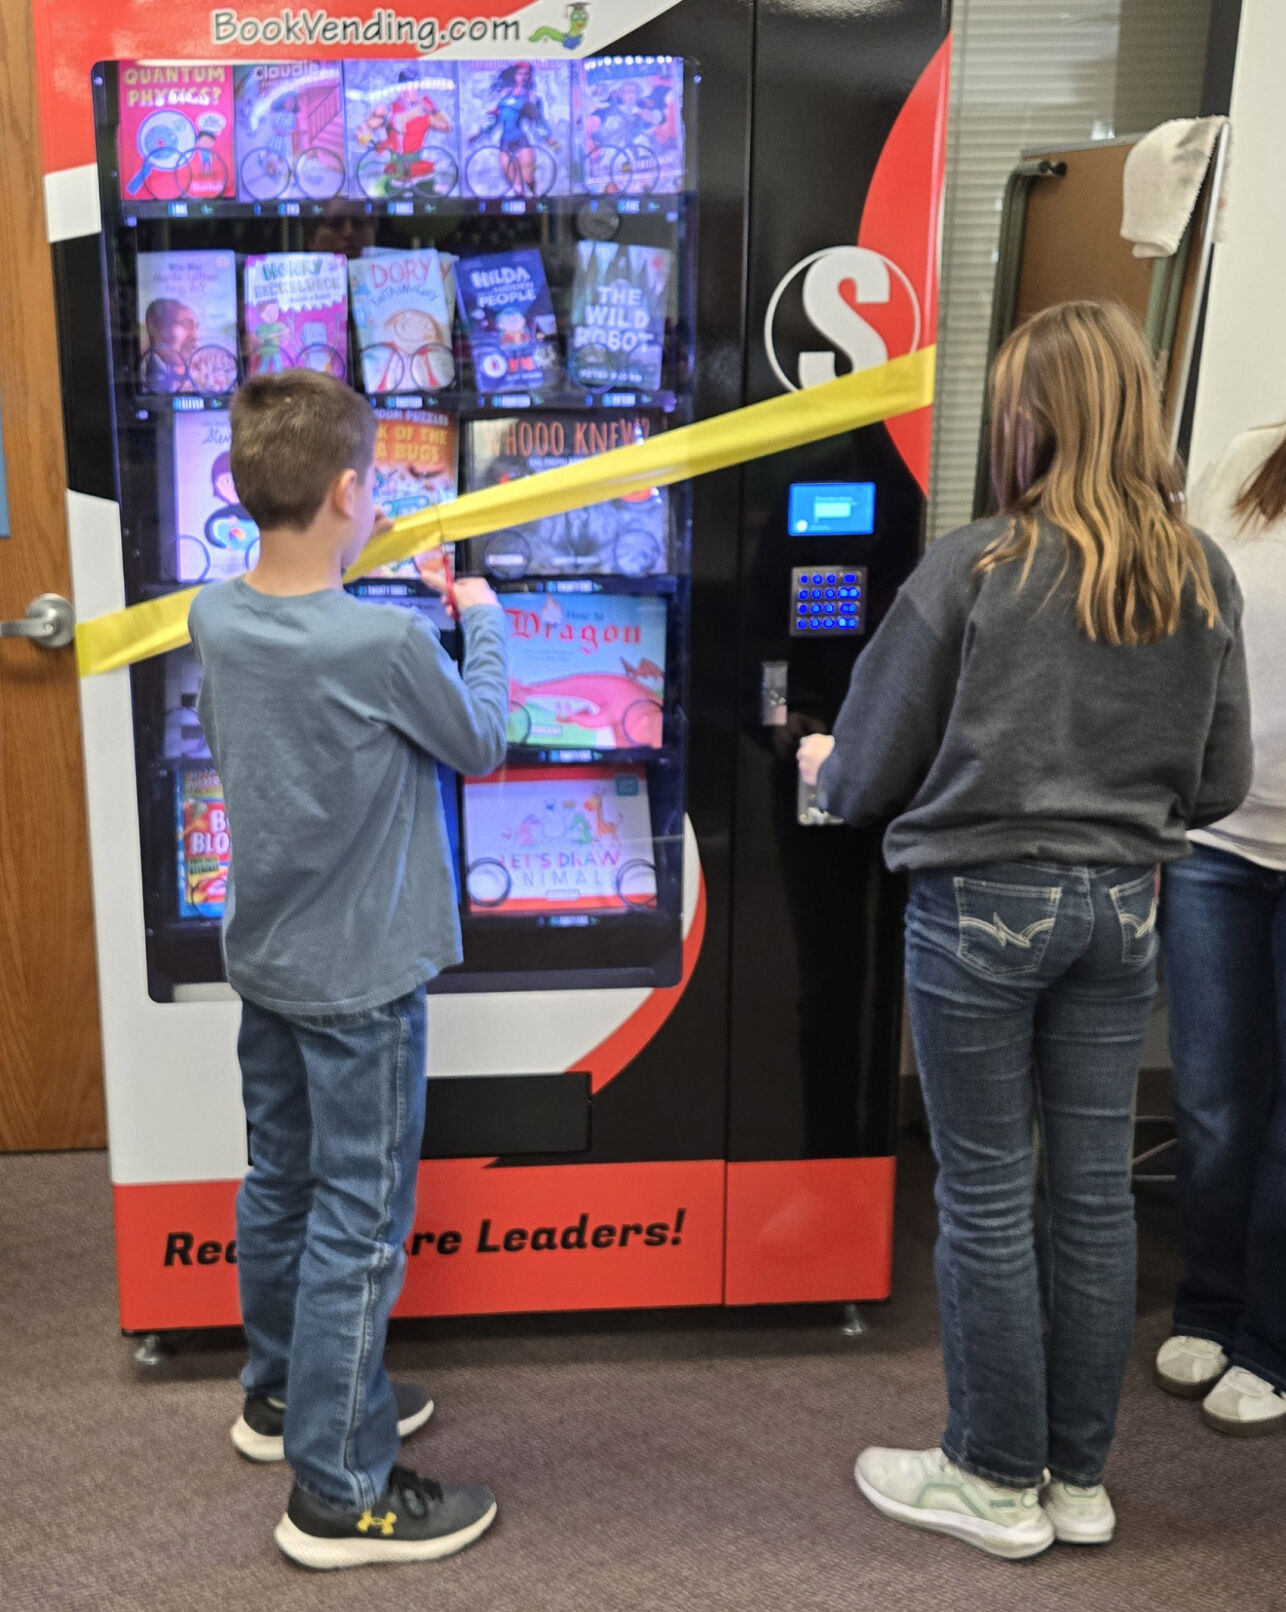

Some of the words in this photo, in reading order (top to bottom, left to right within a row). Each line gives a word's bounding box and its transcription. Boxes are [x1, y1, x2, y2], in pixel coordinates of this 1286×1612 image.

[212, 10, 521, 50] BookVending.com
[124, 66, 226, 85] QUANTUM
[370, 256, 432, 289] DORY
[470, 265, 532, 290] HILDA
[477, 287, 537, 309] PEOPLE
[597, 286, 642, 306] THE
[584, 304, 650, 330] WILD
[574, 326, 654, 353] ROBOT
[395, 442, 440, 465] BUGS
[504, 606, 642, 656] Dragon
[477, 1207, 686, 1253] Leaders!
